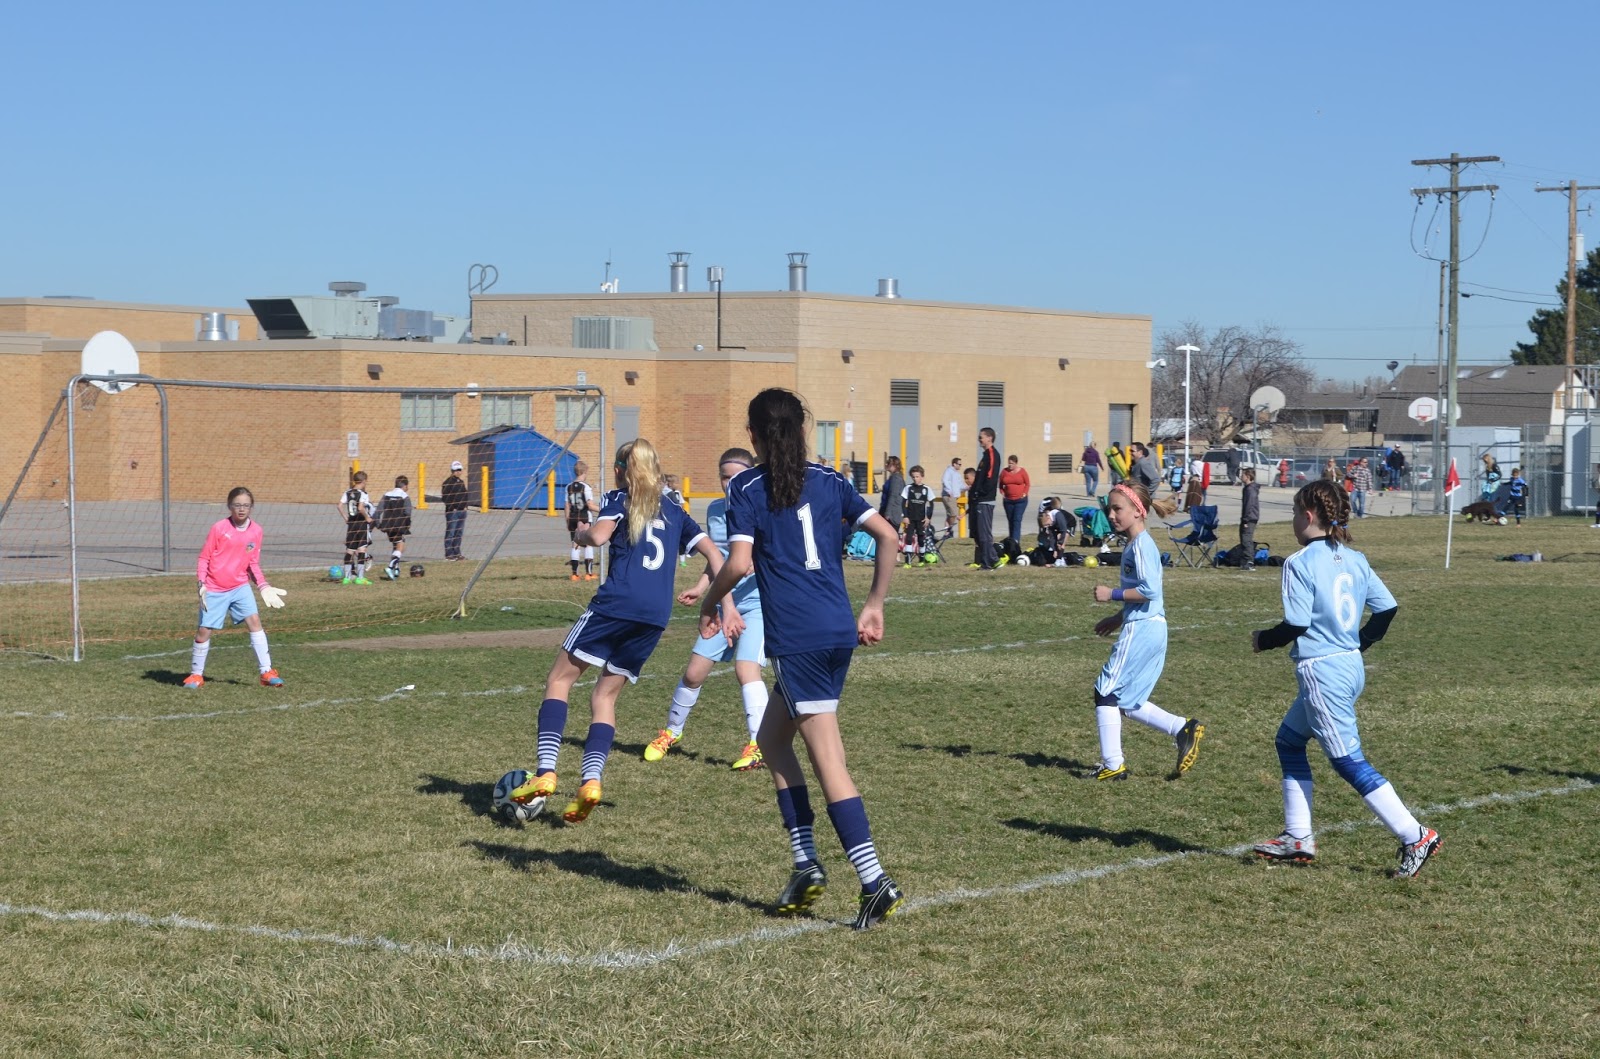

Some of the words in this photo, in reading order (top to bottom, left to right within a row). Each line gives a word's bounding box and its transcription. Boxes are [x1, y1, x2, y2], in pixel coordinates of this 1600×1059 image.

[569, 491, 585, 510] 15
[642, 518, 665, 571] 5
[797, 502, 821, 571] 1
[1333, 572, 1357, 632] 6
